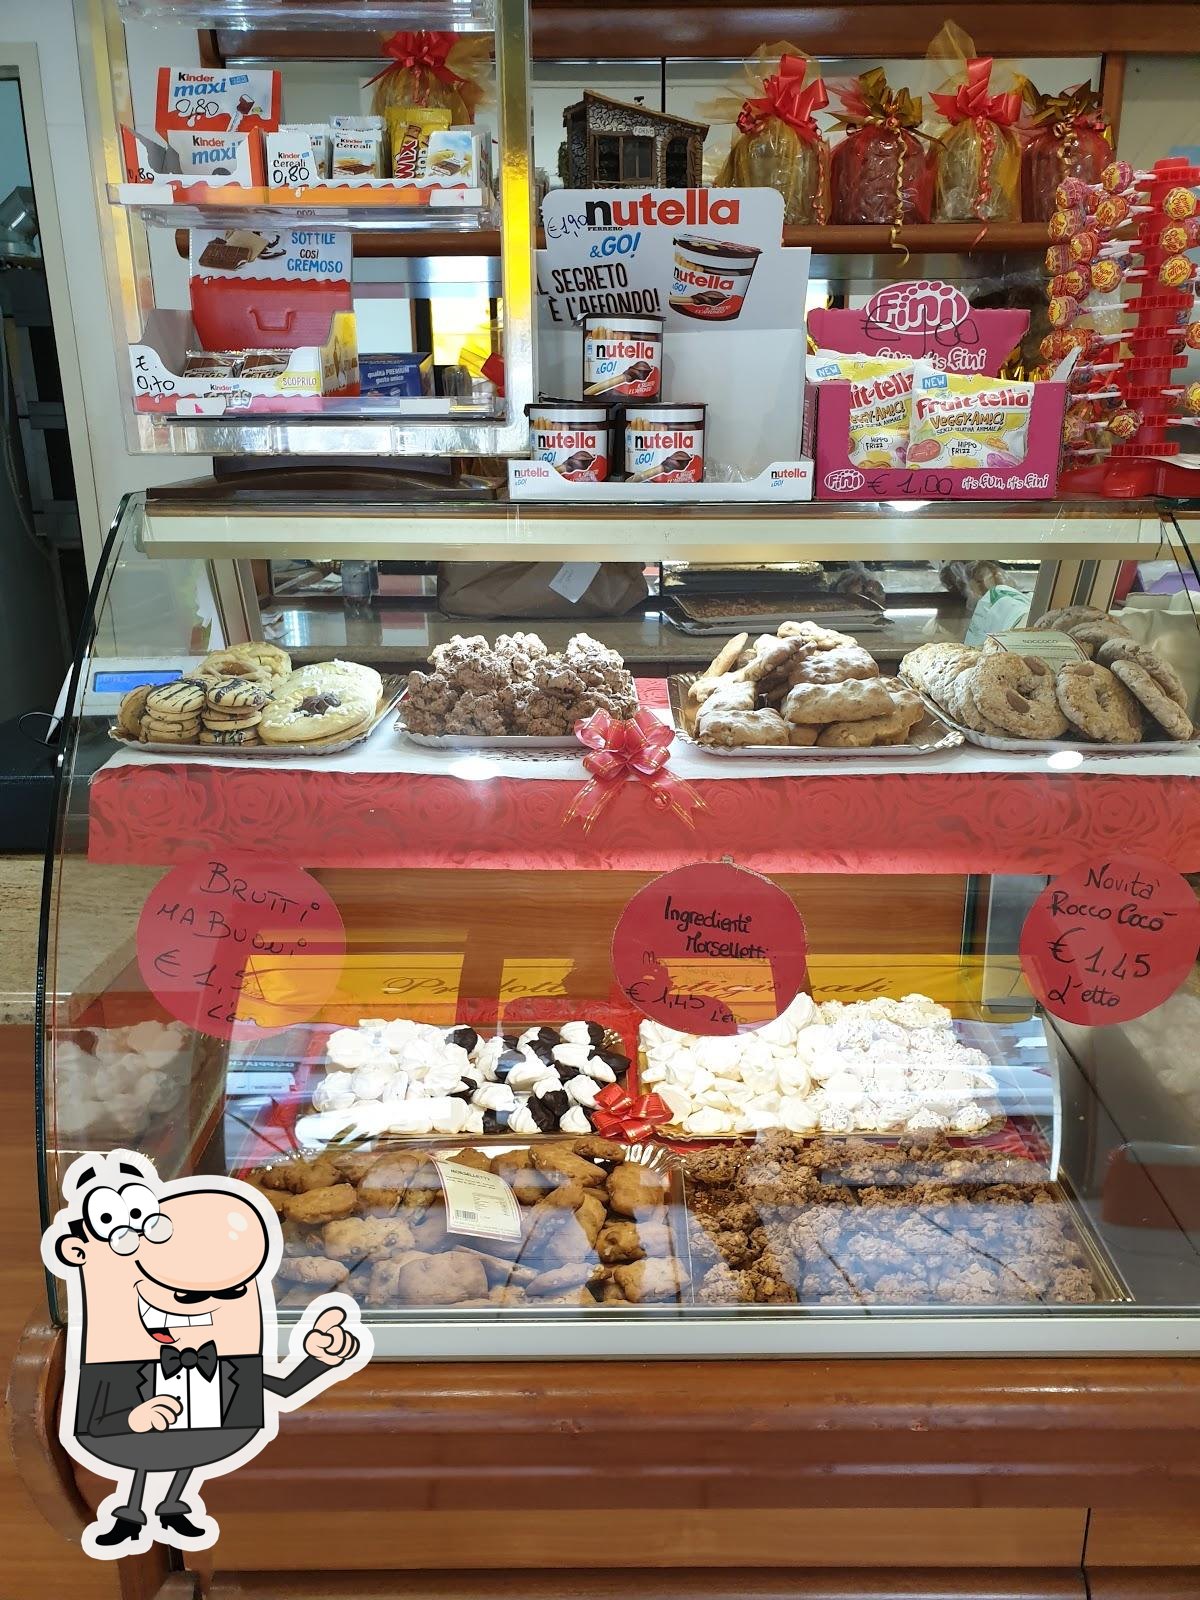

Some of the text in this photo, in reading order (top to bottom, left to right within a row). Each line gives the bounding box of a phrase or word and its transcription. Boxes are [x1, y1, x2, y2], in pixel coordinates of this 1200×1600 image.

[178, 72, 215, 82] Kinder
[174, 79, 227, 98] maxi
[175, 98, 220, 120] 0,80
[192, 135, 225, 147] Kinder
[192, 142, 236, 165] maxi
[272, 164, 310, 185] 0,80
[585, 189, 740, 227] nutella
[291, 232, 336, 246] SOTTILE
[287, 258, 343, 273] CREMOSO
[551, 262, 629, 294] SEGRETO
[673, 266, 734, 291] nutella
[596, 341, 654, 360] nutella
[817, 366, 838, 377] NEW
[282, 377, 317, 387] SCOPRILO
[924, 377, 946, 388] NEW
[538, 432, 596, 449] nutella
[634, 432, 694, 449] nutella
[957, 441, 977, 449] HIPPO
[951, 447, 971, 456] FRIZZ
[514, 467, 550, 478] nutella
[771, 468, 807, 479] nutella
[157, 903, 195, 926] MA
[664, 895, 752, 933] Ingredienti
[1046, 926, 1087, 964] €
